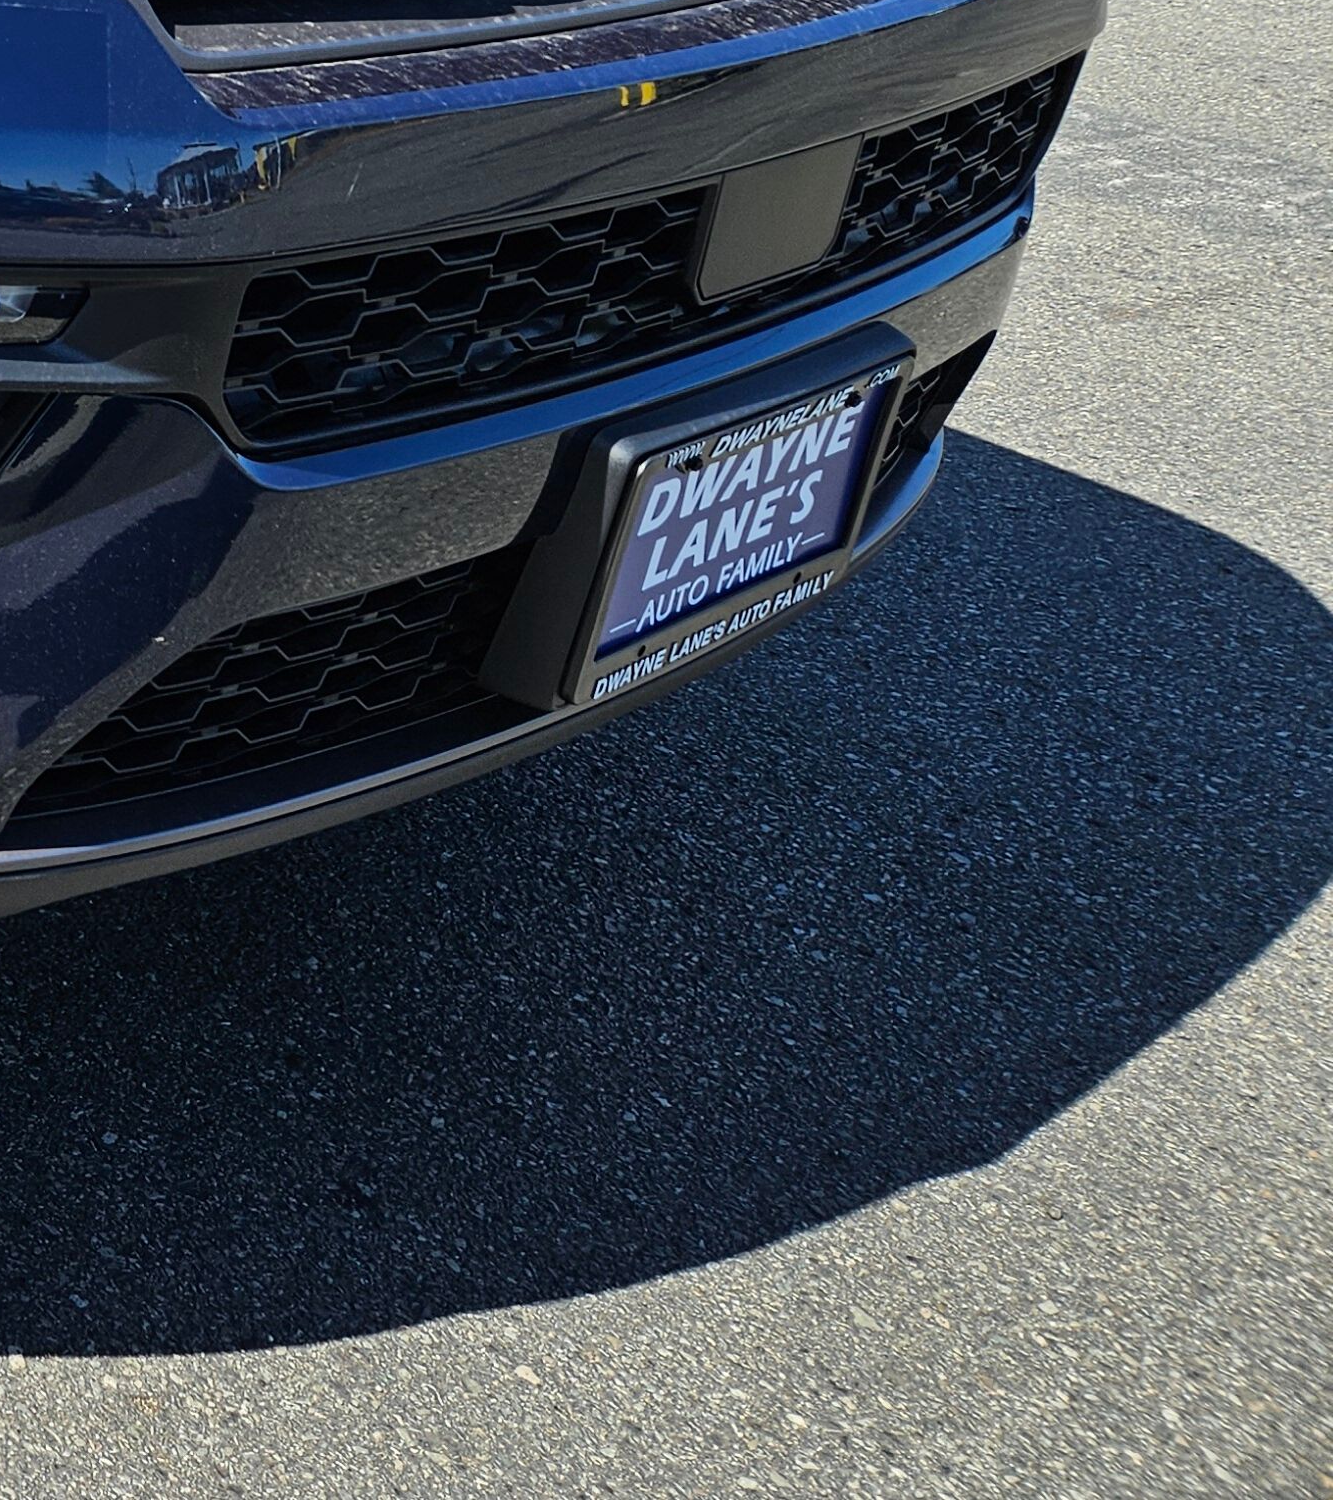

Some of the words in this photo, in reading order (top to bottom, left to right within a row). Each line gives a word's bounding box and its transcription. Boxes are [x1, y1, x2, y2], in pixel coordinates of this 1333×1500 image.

[637, 401, 866, 537] DWAYNE
[641, 469, 823, 592] LANE'S
[592, 649, 667, 700] DWAYNE
[669, 620, 728, 662] LANE'S
[727, 599, 772, 635] AUTO
[773, 570, 835, 614] FAMILY
[635, 574, 709, 633] AUTO
[716, 532, 804, 594] FAMILY
